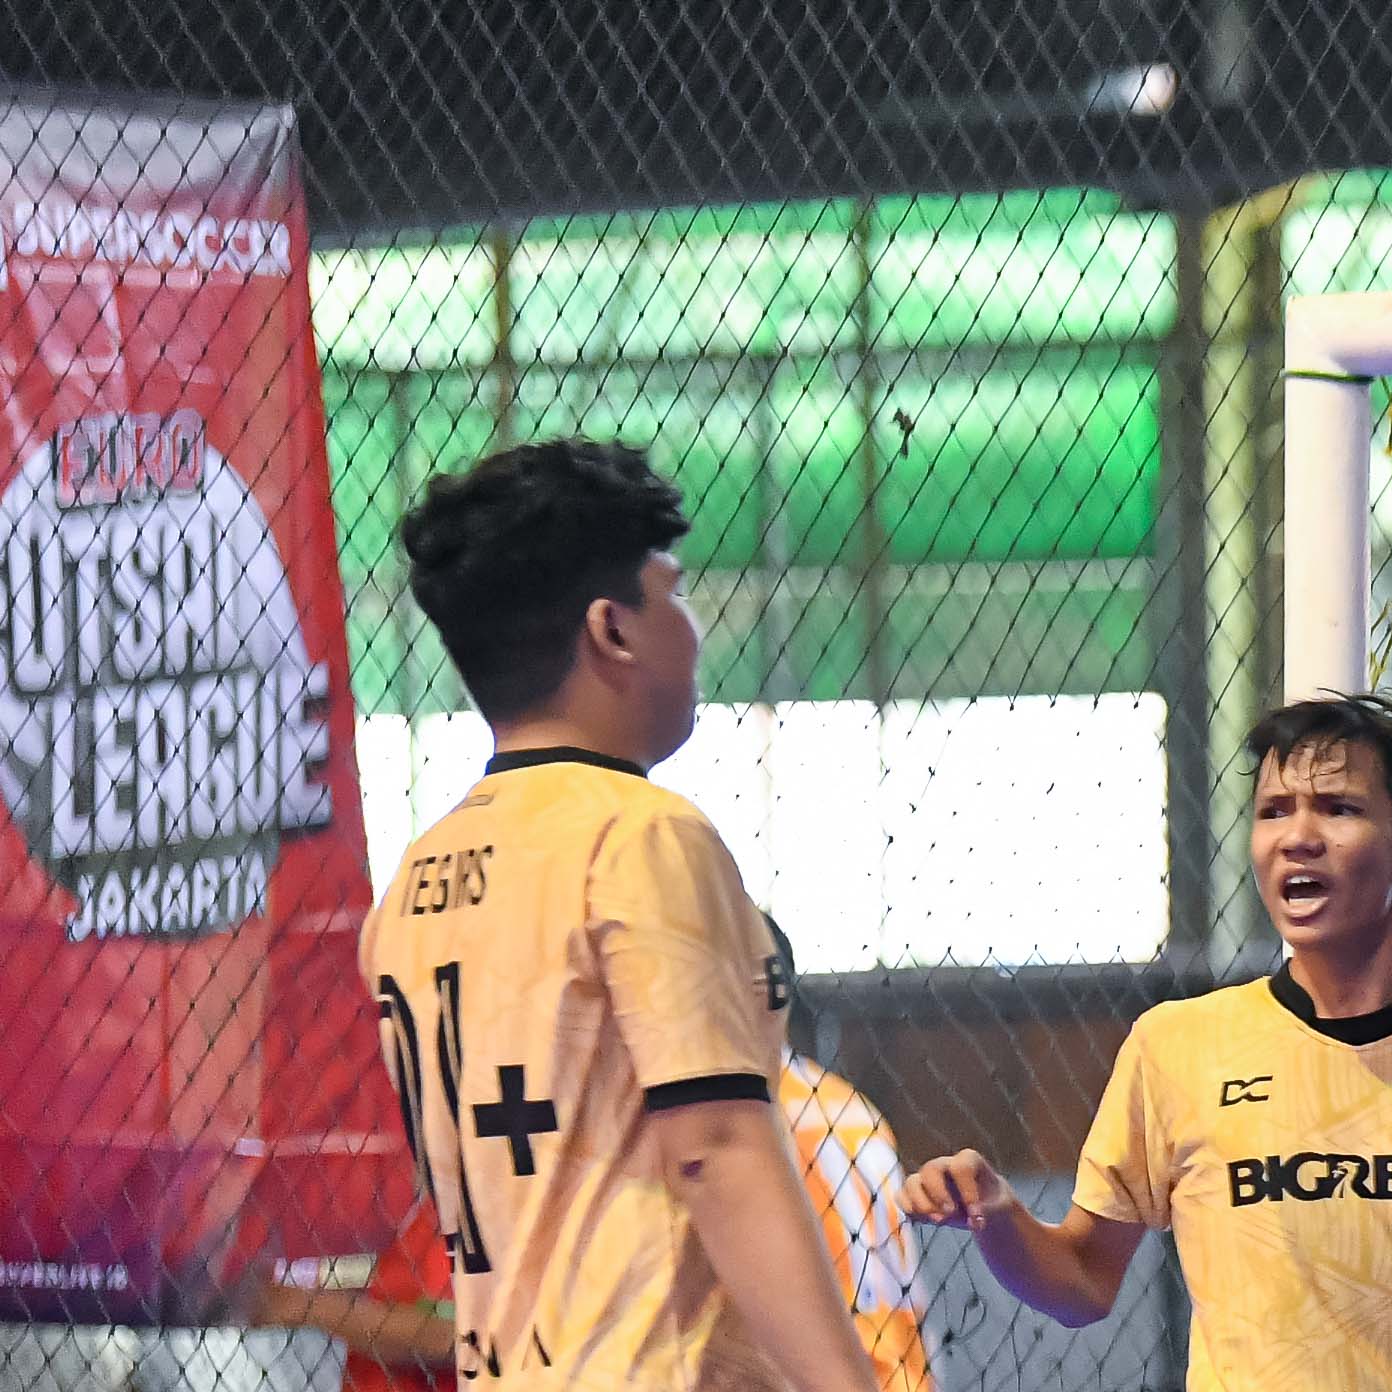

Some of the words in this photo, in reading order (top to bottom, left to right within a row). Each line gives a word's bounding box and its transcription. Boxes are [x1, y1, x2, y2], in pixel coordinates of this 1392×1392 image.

[0, 510, 254, 693] UTSAL
[50, 662, 333, 858] LEAGUE
[66, 850, 268, 942] JAKARTA
[1218, 1075, 1274, 1107] DC
